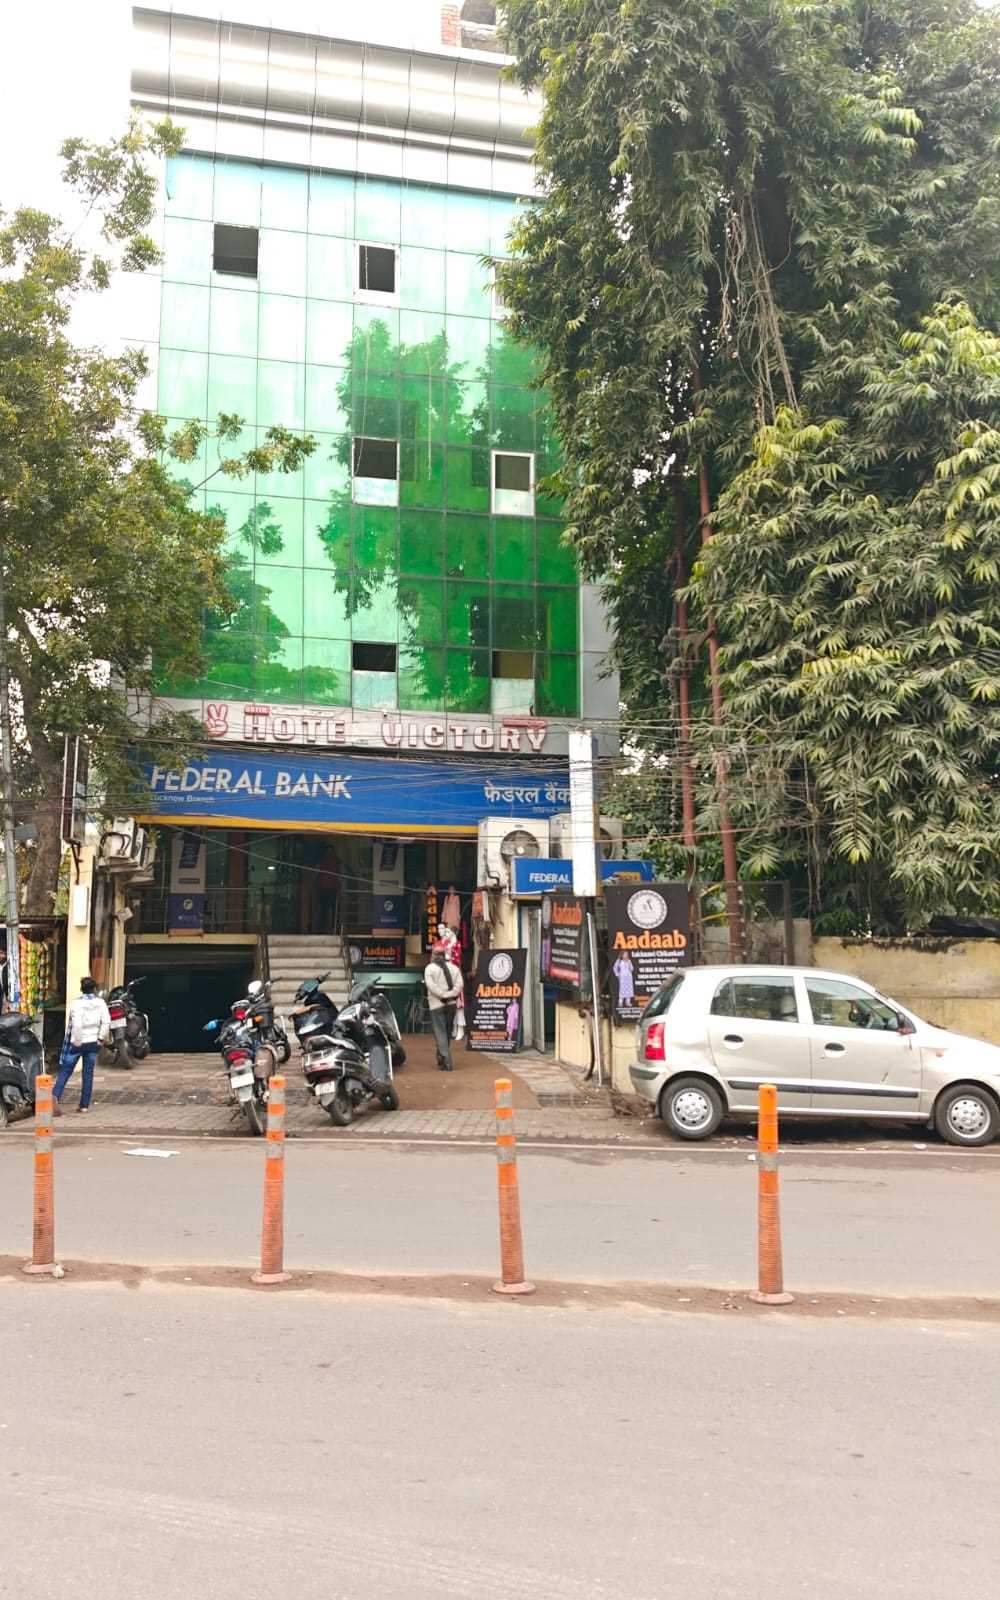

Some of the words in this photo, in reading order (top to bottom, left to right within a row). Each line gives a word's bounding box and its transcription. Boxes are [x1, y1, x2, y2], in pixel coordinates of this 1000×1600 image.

[381, 720, 547, 751] VICTORY
[150, 765, 266, 795] FEDERAL
[274, 772, 352, 799] BANK
[529, 872, 570, 884] FEDERAL
[613, 928, 688, 950] Aadaab
[475, 982, 521, 998] Aadaab
